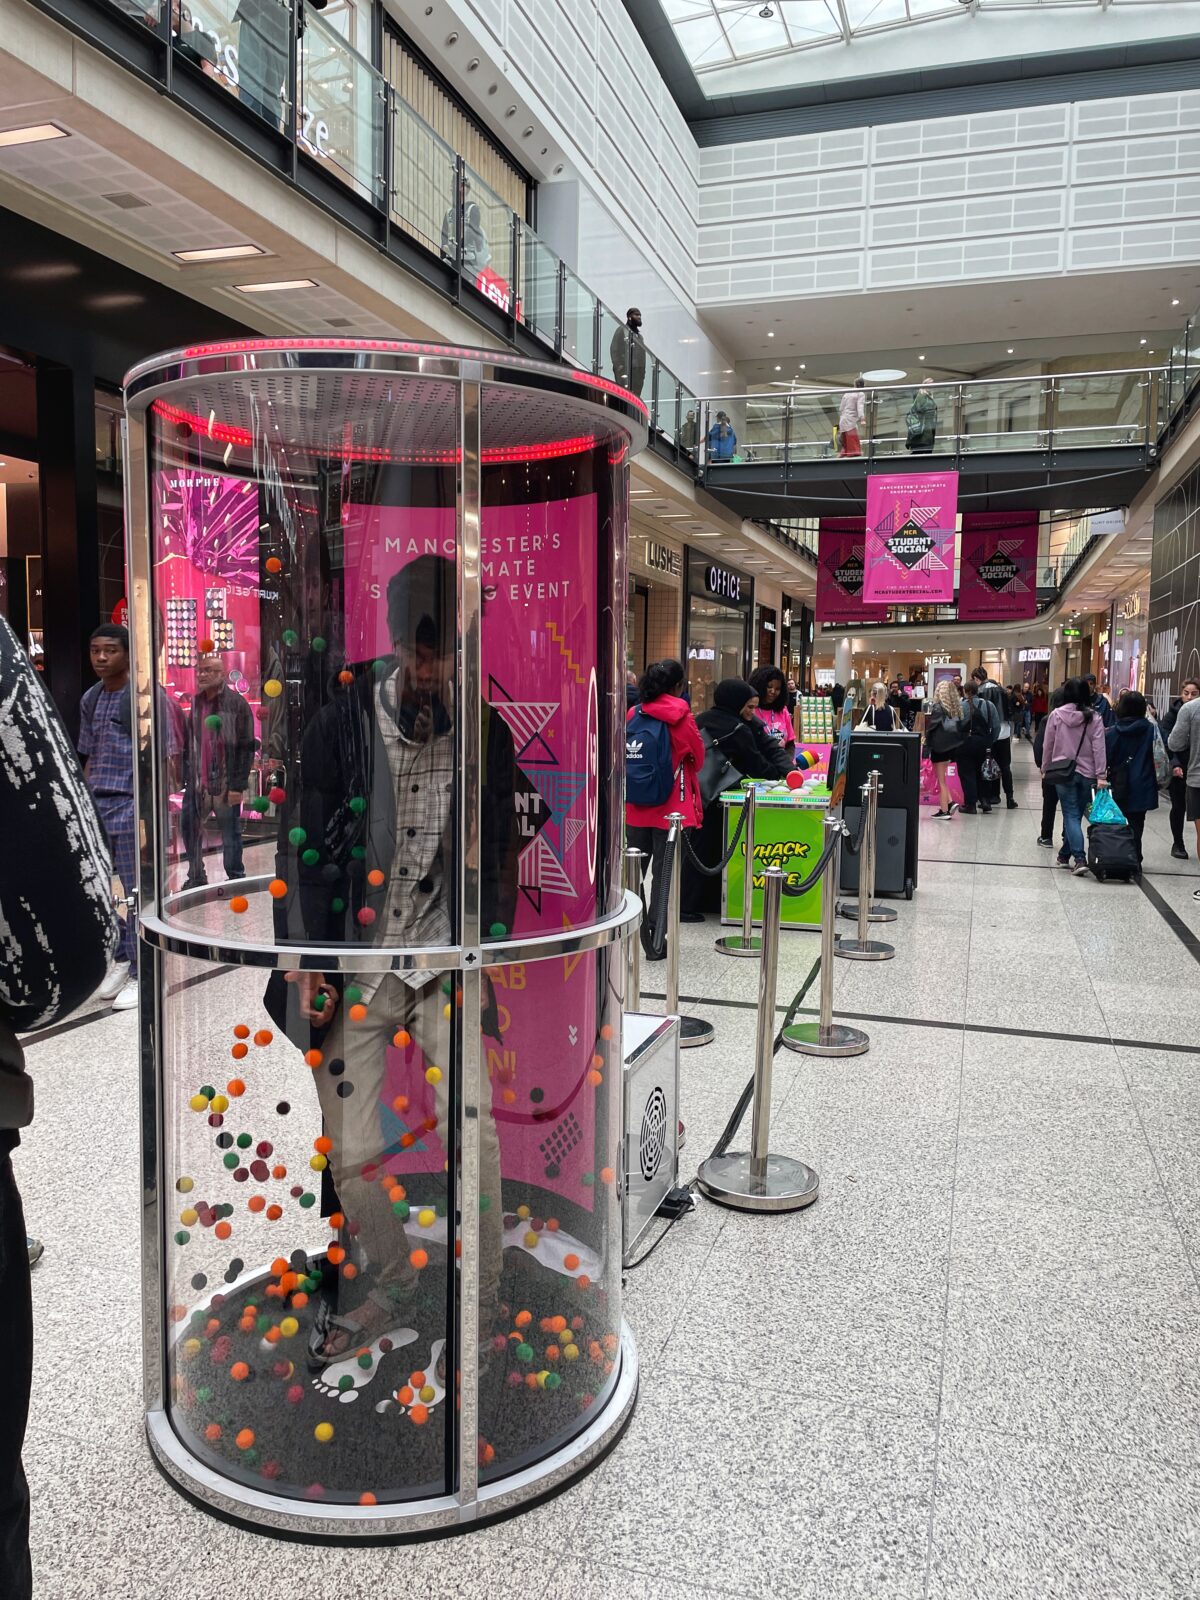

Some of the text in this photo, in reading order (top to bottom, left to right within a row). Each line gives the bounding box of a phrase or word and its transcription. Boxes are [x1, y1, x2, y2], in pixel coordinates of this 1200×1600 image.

[169, 477, 220, 488] MORPHE
[385, 532, 561, 554] MANCESTER'S
[887, 537, 932, 546] STUDENT
[891, 545, 929, 554] SOCIAL
[647, 541, 673, 573] LUSH
[979, 565, 1017, 573] STUDENT
[510, 581, 570, 600] EVENT
[710, 566, 741, 600] OFFICE
[1150, 627, 1179, 674] COMING
[924, 656, 951, 666] NEXT
[752, 873, 800, 889] ME
